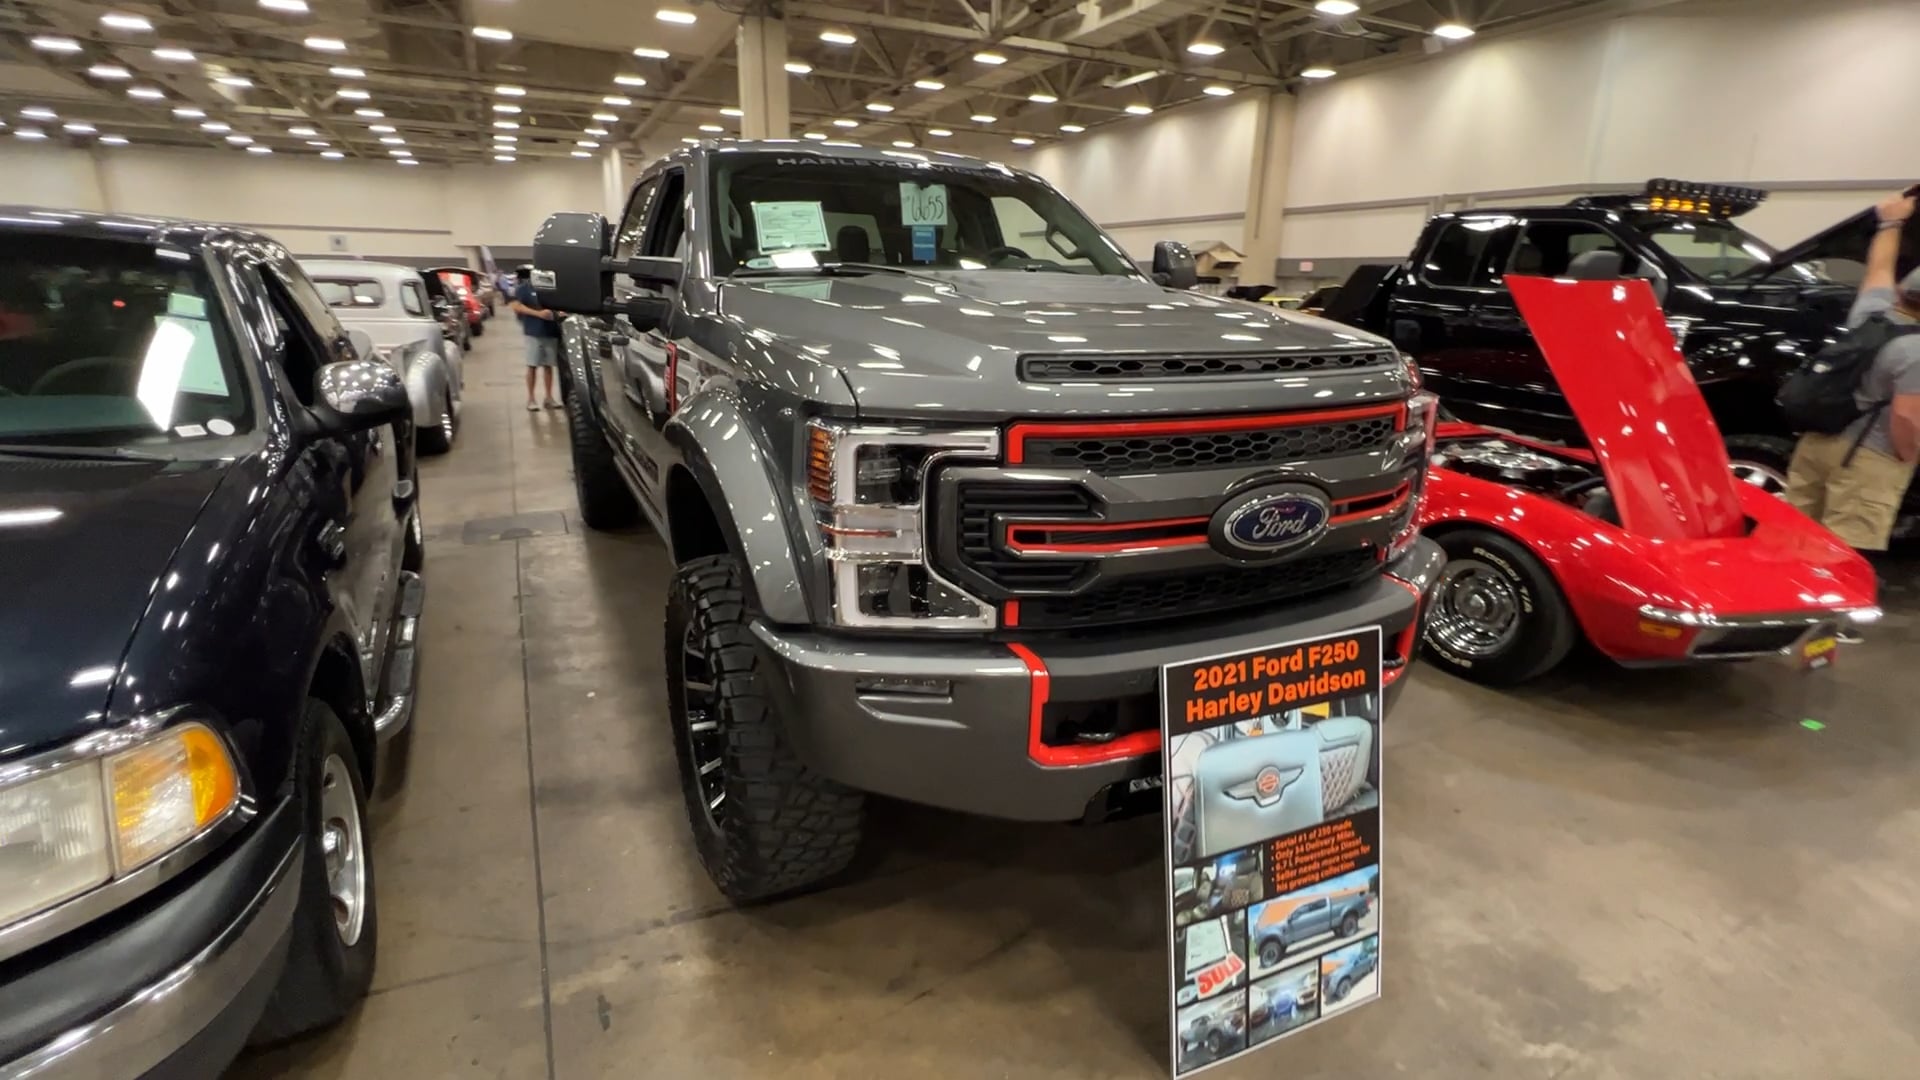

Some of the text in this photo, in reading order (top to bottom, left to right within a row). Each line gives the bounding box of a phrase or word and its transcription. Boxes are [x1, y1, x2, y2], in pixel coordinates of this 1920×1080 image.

[1252, 506, 1309, 539] Ford
[1473, 547, 1521, 582] Radial
[1194, 640, 1360, 691] 2021 Ford F250
[1186, 668, 1366, 723] Harley Davidson
[1275, 836, 1297, 850] Serial
[1275, 846, 1294, 861] Only
